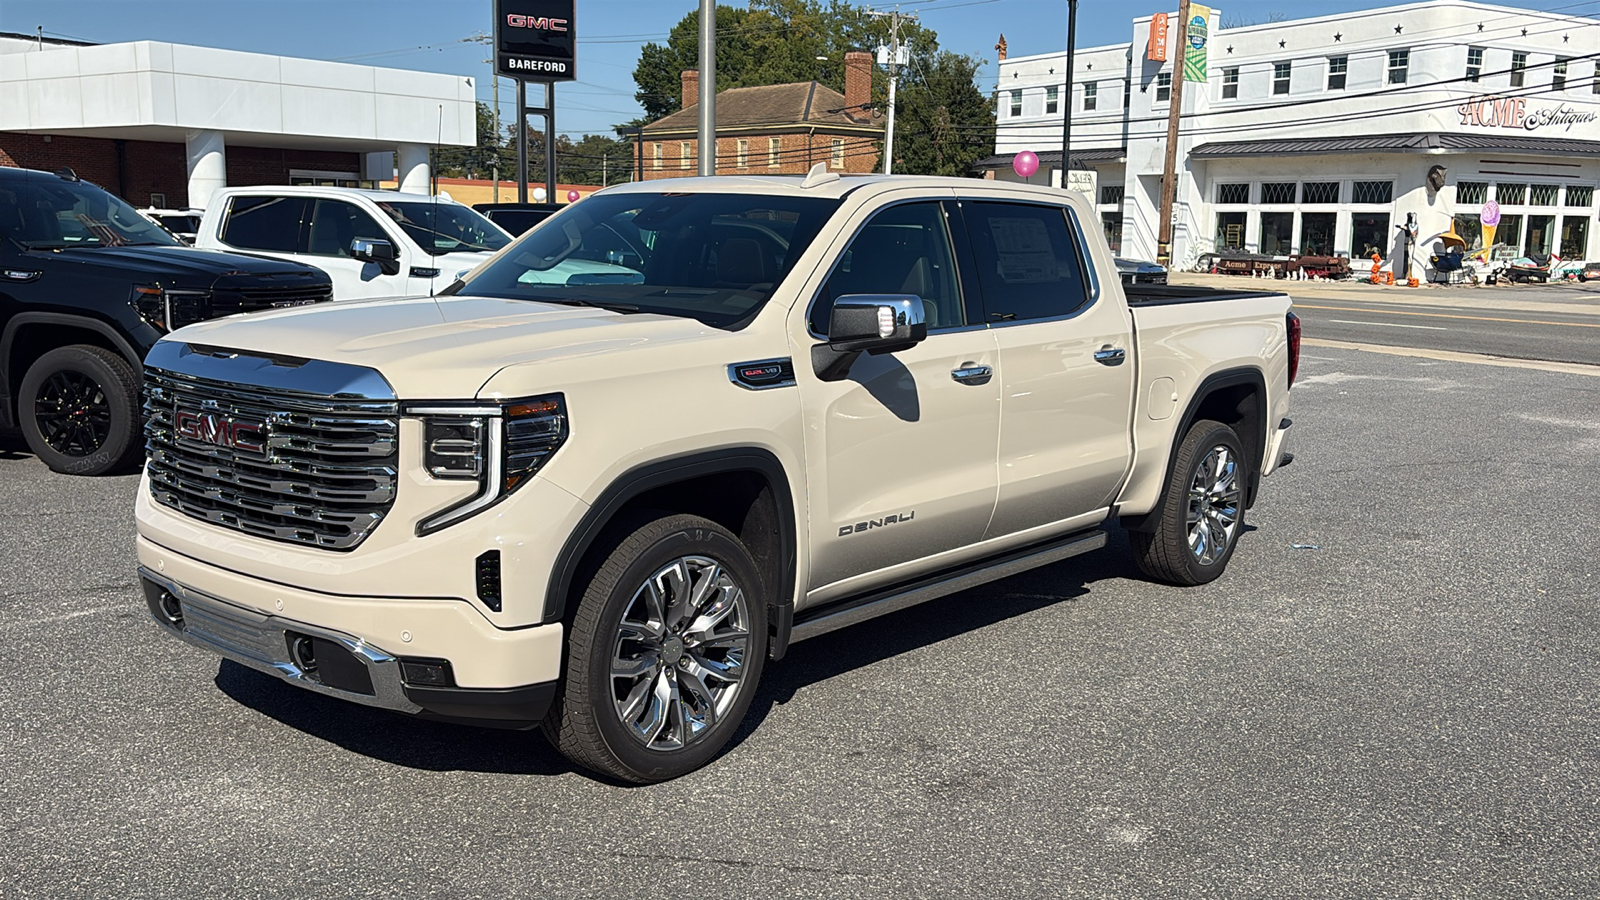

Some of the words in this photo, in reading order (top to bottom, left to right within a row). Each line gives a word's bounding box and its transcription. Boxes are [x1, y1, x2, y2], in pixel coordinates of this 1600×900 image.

[507, 14, 568, 31] GMC
[1157, 16, 1166, 58] ACME
[508, 58, 567, 72] BAREFORD
[1458, 95, 1527, 129] ACME
[1540, 102, 1598, 132] Antiques
[1224, 261, 1247, 269] Acme
[177, 410, 266, 454] GMC
[838, 510, 915, 537] DENALI
